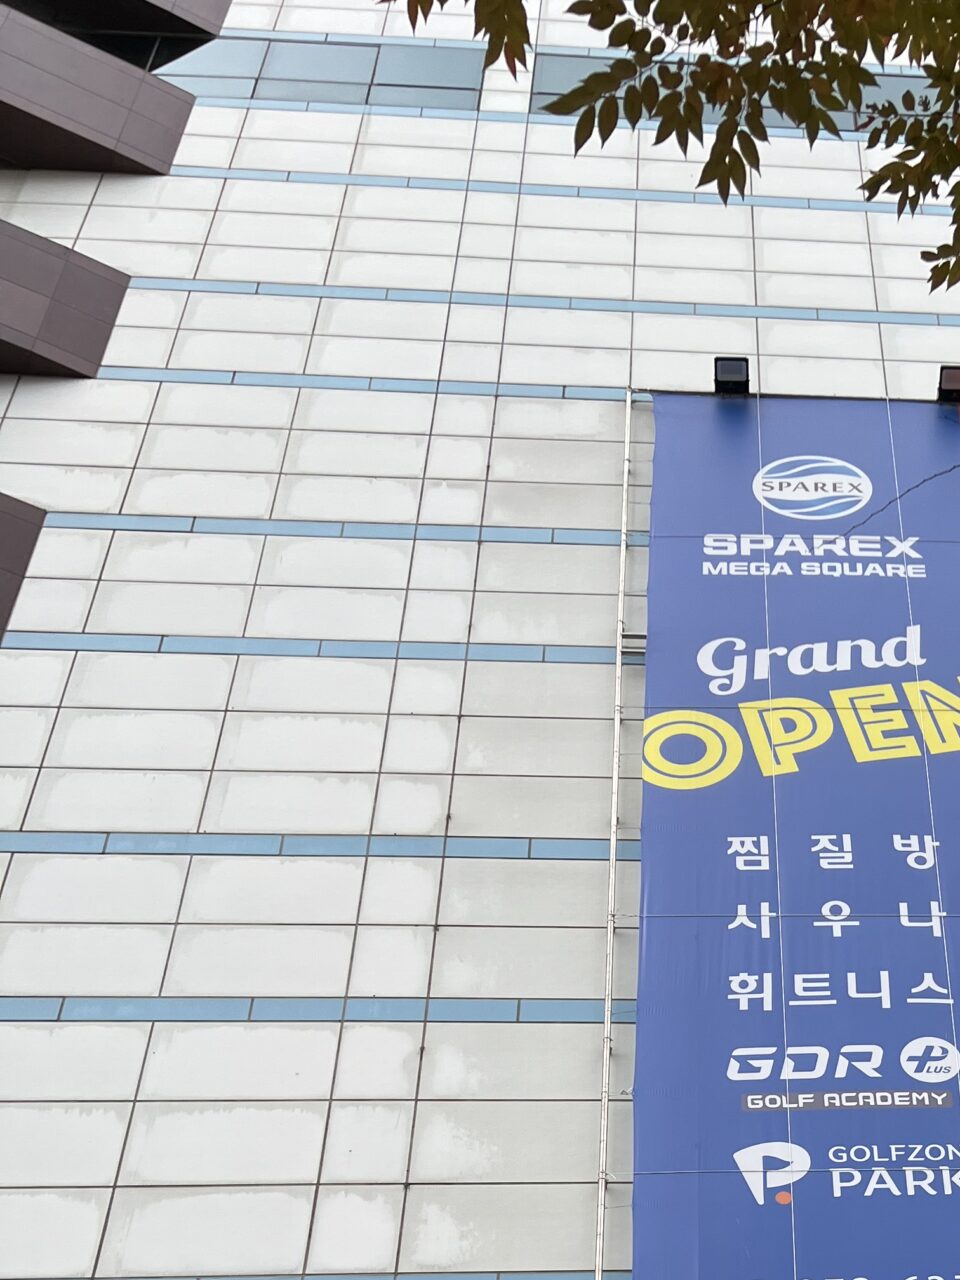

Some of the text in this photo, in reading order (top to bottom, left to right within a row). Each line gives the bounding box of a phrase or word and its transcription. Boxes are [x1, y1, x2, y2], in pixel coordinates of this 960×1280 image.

[762, 480, 863, 495] SPAREX
[702, 533, 924, 559] SPAREX
[702, 561, 927, 578] MEGA SQUARE
[696, 624, 927, 696] Grand
[727, 970, 955, 1012] 휘트니스
[726, 1044, 884, 1081] GDR
[746, 1091, 947, 1109] GOLF ACADEMY
